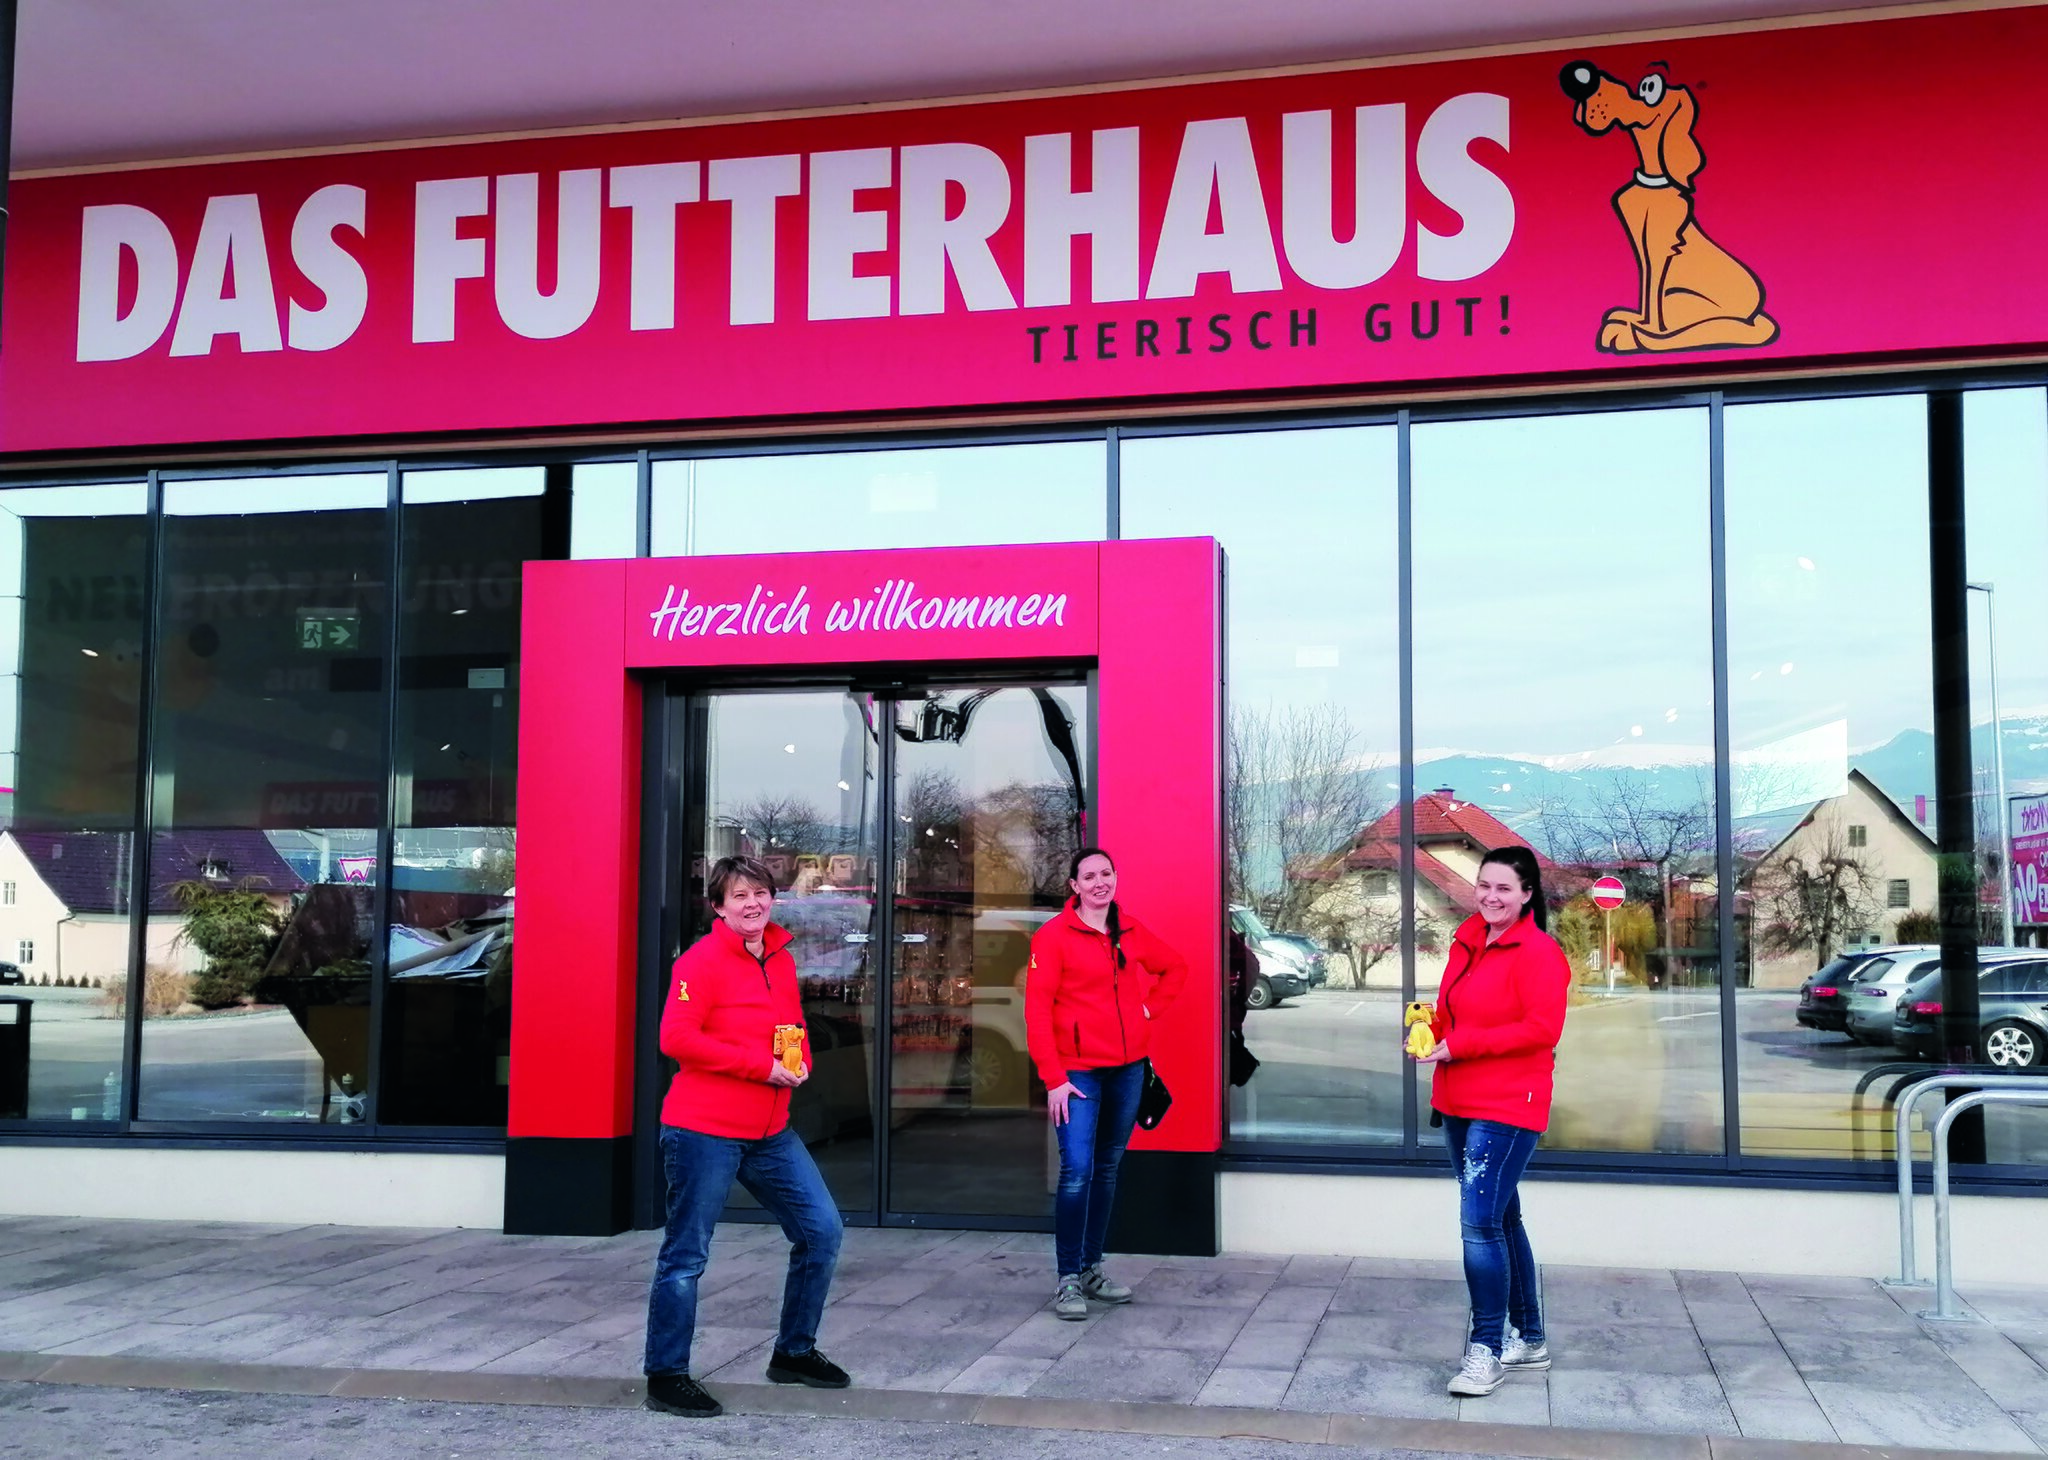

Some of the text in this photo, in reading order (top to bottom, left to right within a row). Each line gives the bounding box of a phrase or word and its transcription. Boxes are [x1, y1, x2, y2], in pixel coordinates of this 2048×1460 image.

[77, 93, 1516, 363] DAS FUTTERHAUS
[1027, 295, 1511, 364] TIERISCH GUT!
[650, 579, 1067, 641] Herzlich willkommen
